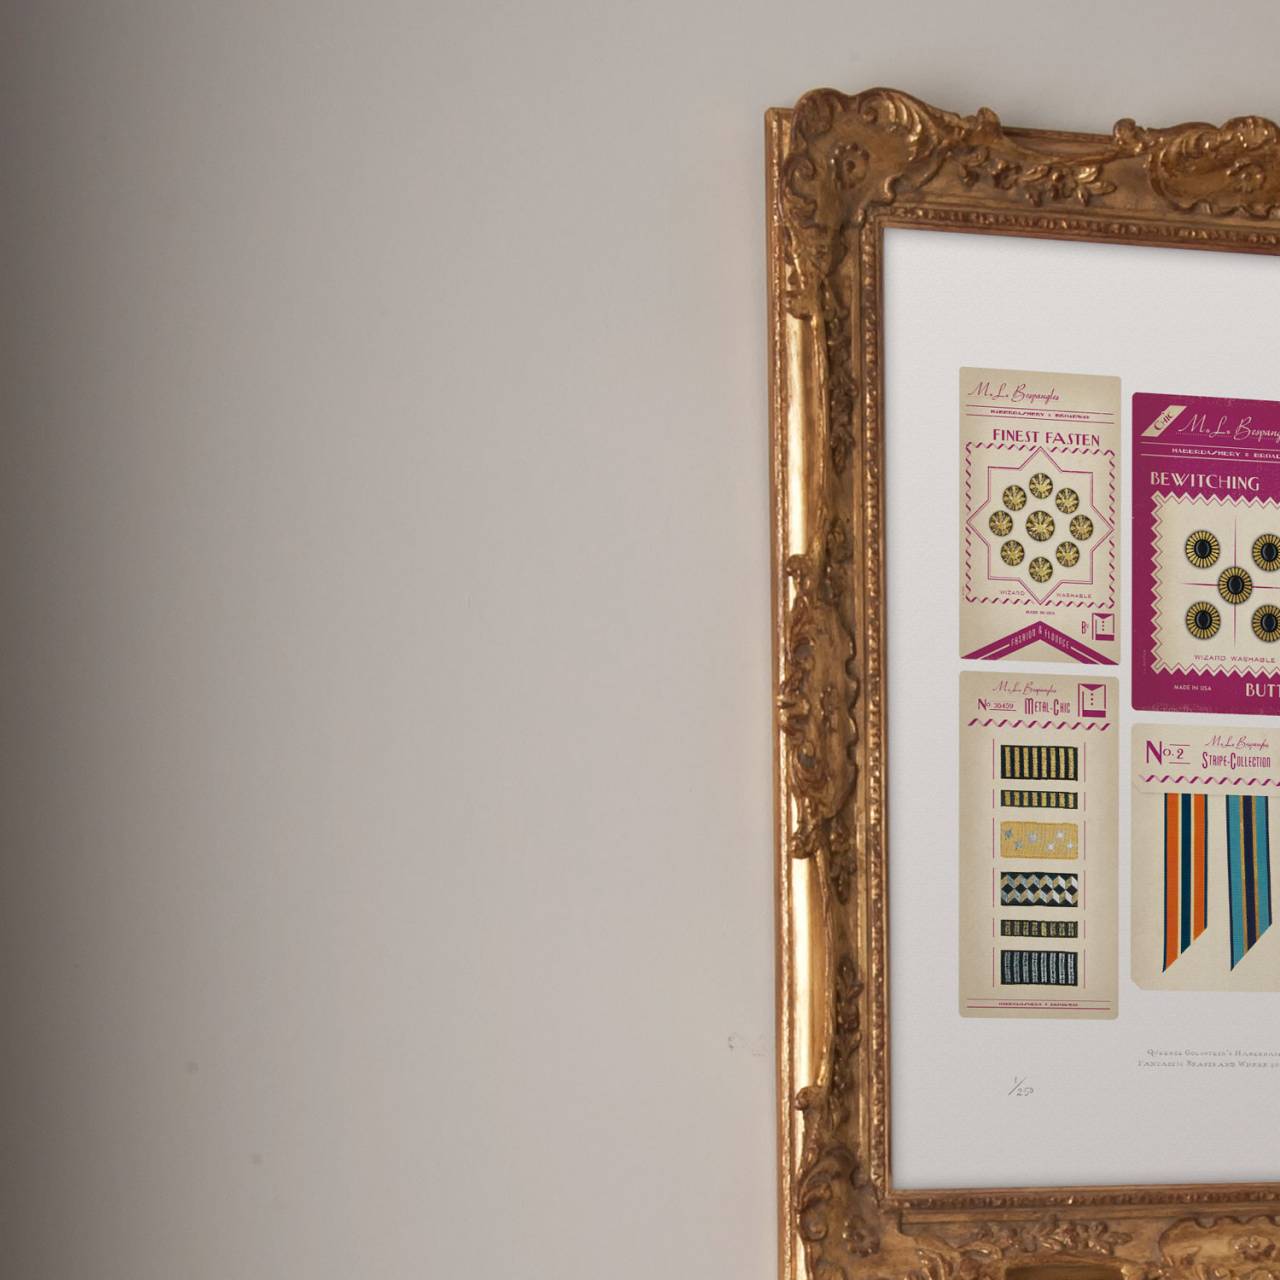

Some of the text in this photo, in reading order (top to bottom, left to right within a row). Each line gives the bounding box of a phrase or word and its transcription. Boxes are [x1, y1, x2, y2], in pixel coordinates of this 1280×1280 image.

[992, 428, 1100, 446] FINEST FASTEN
[1150, 471, 1260, 491] BEWITCHING
[1024, 698, 1070, 715] METAL-CHIC
[1177, 748, 1184, 760] 2
[1202, 751, 1271, 769] STRIPE-COLLECTION
